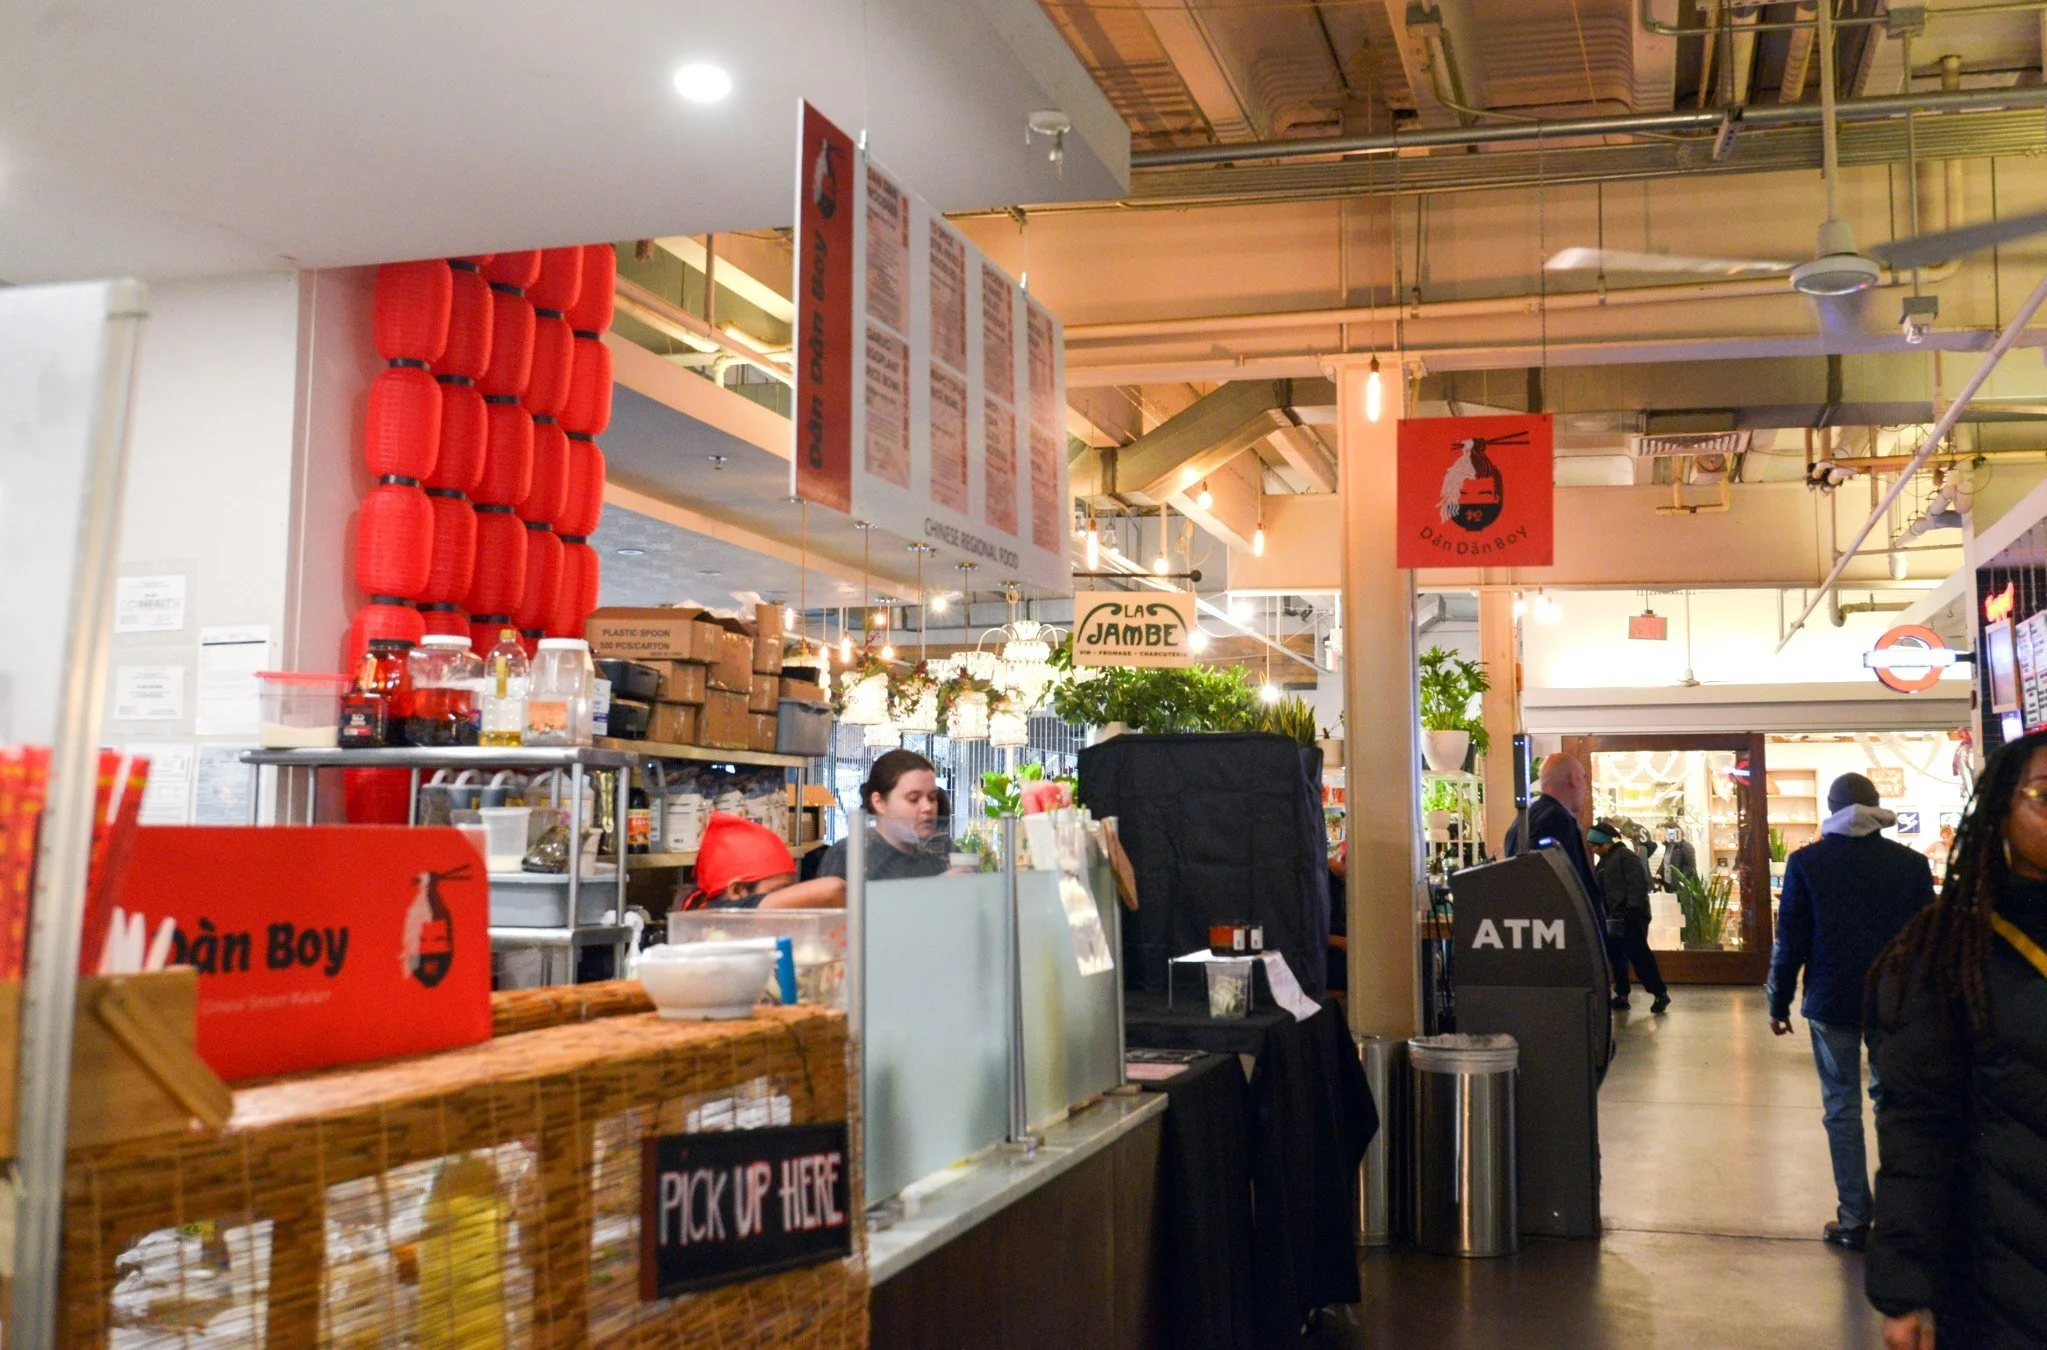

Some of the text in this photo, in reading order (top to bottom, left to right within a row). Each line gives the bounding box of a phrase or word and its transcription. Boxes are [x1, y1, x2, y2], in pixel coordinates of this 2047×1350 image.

[924, 516, 1019, 571] CHINESE REGIONAL FOOD
[1494, 525, 1527, 550] Boy
[1124, 604, 1144, 618] LA
[603, 628, 670, 637] PLASTIC SPOON
[1086, 622, 1178, 646] JAMBE
[615, 641, 670, 651] PCS/CARTON
[1471, 918, 1566, 950] ATM
[266, 921, 348, 977] Boy
[659, 1151, 845, 1247] PICK UP HERE
